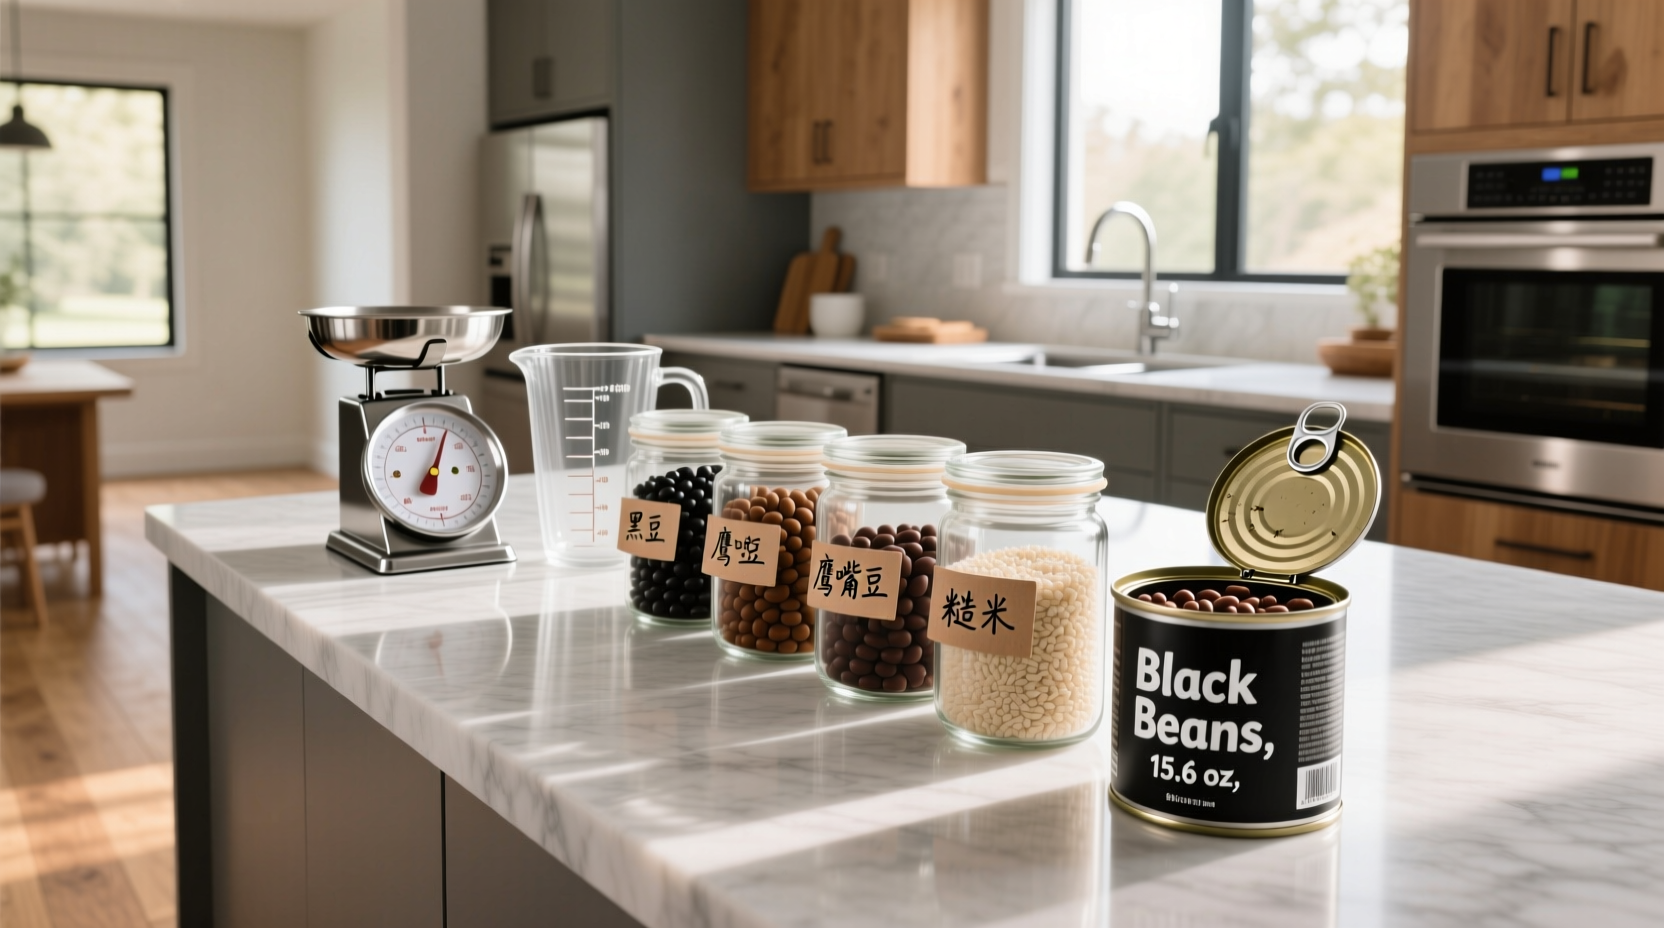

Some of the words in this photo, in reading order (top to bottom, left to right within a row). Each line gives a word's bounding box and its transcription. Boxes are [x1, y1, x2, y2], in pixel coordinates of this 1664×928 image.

[626, 511, 666, 543] 黑豆
[813, 553, 888, 600] 鹰嘴豆
[941, 587, 1015, 636] 糙米
[1136, 647, 1256, 705] Black
[1134, 694, 1275, 761] Beans,
[1150, 753, 1197, 785] 15.6
[1203, 769, 1240, 794] oz,
